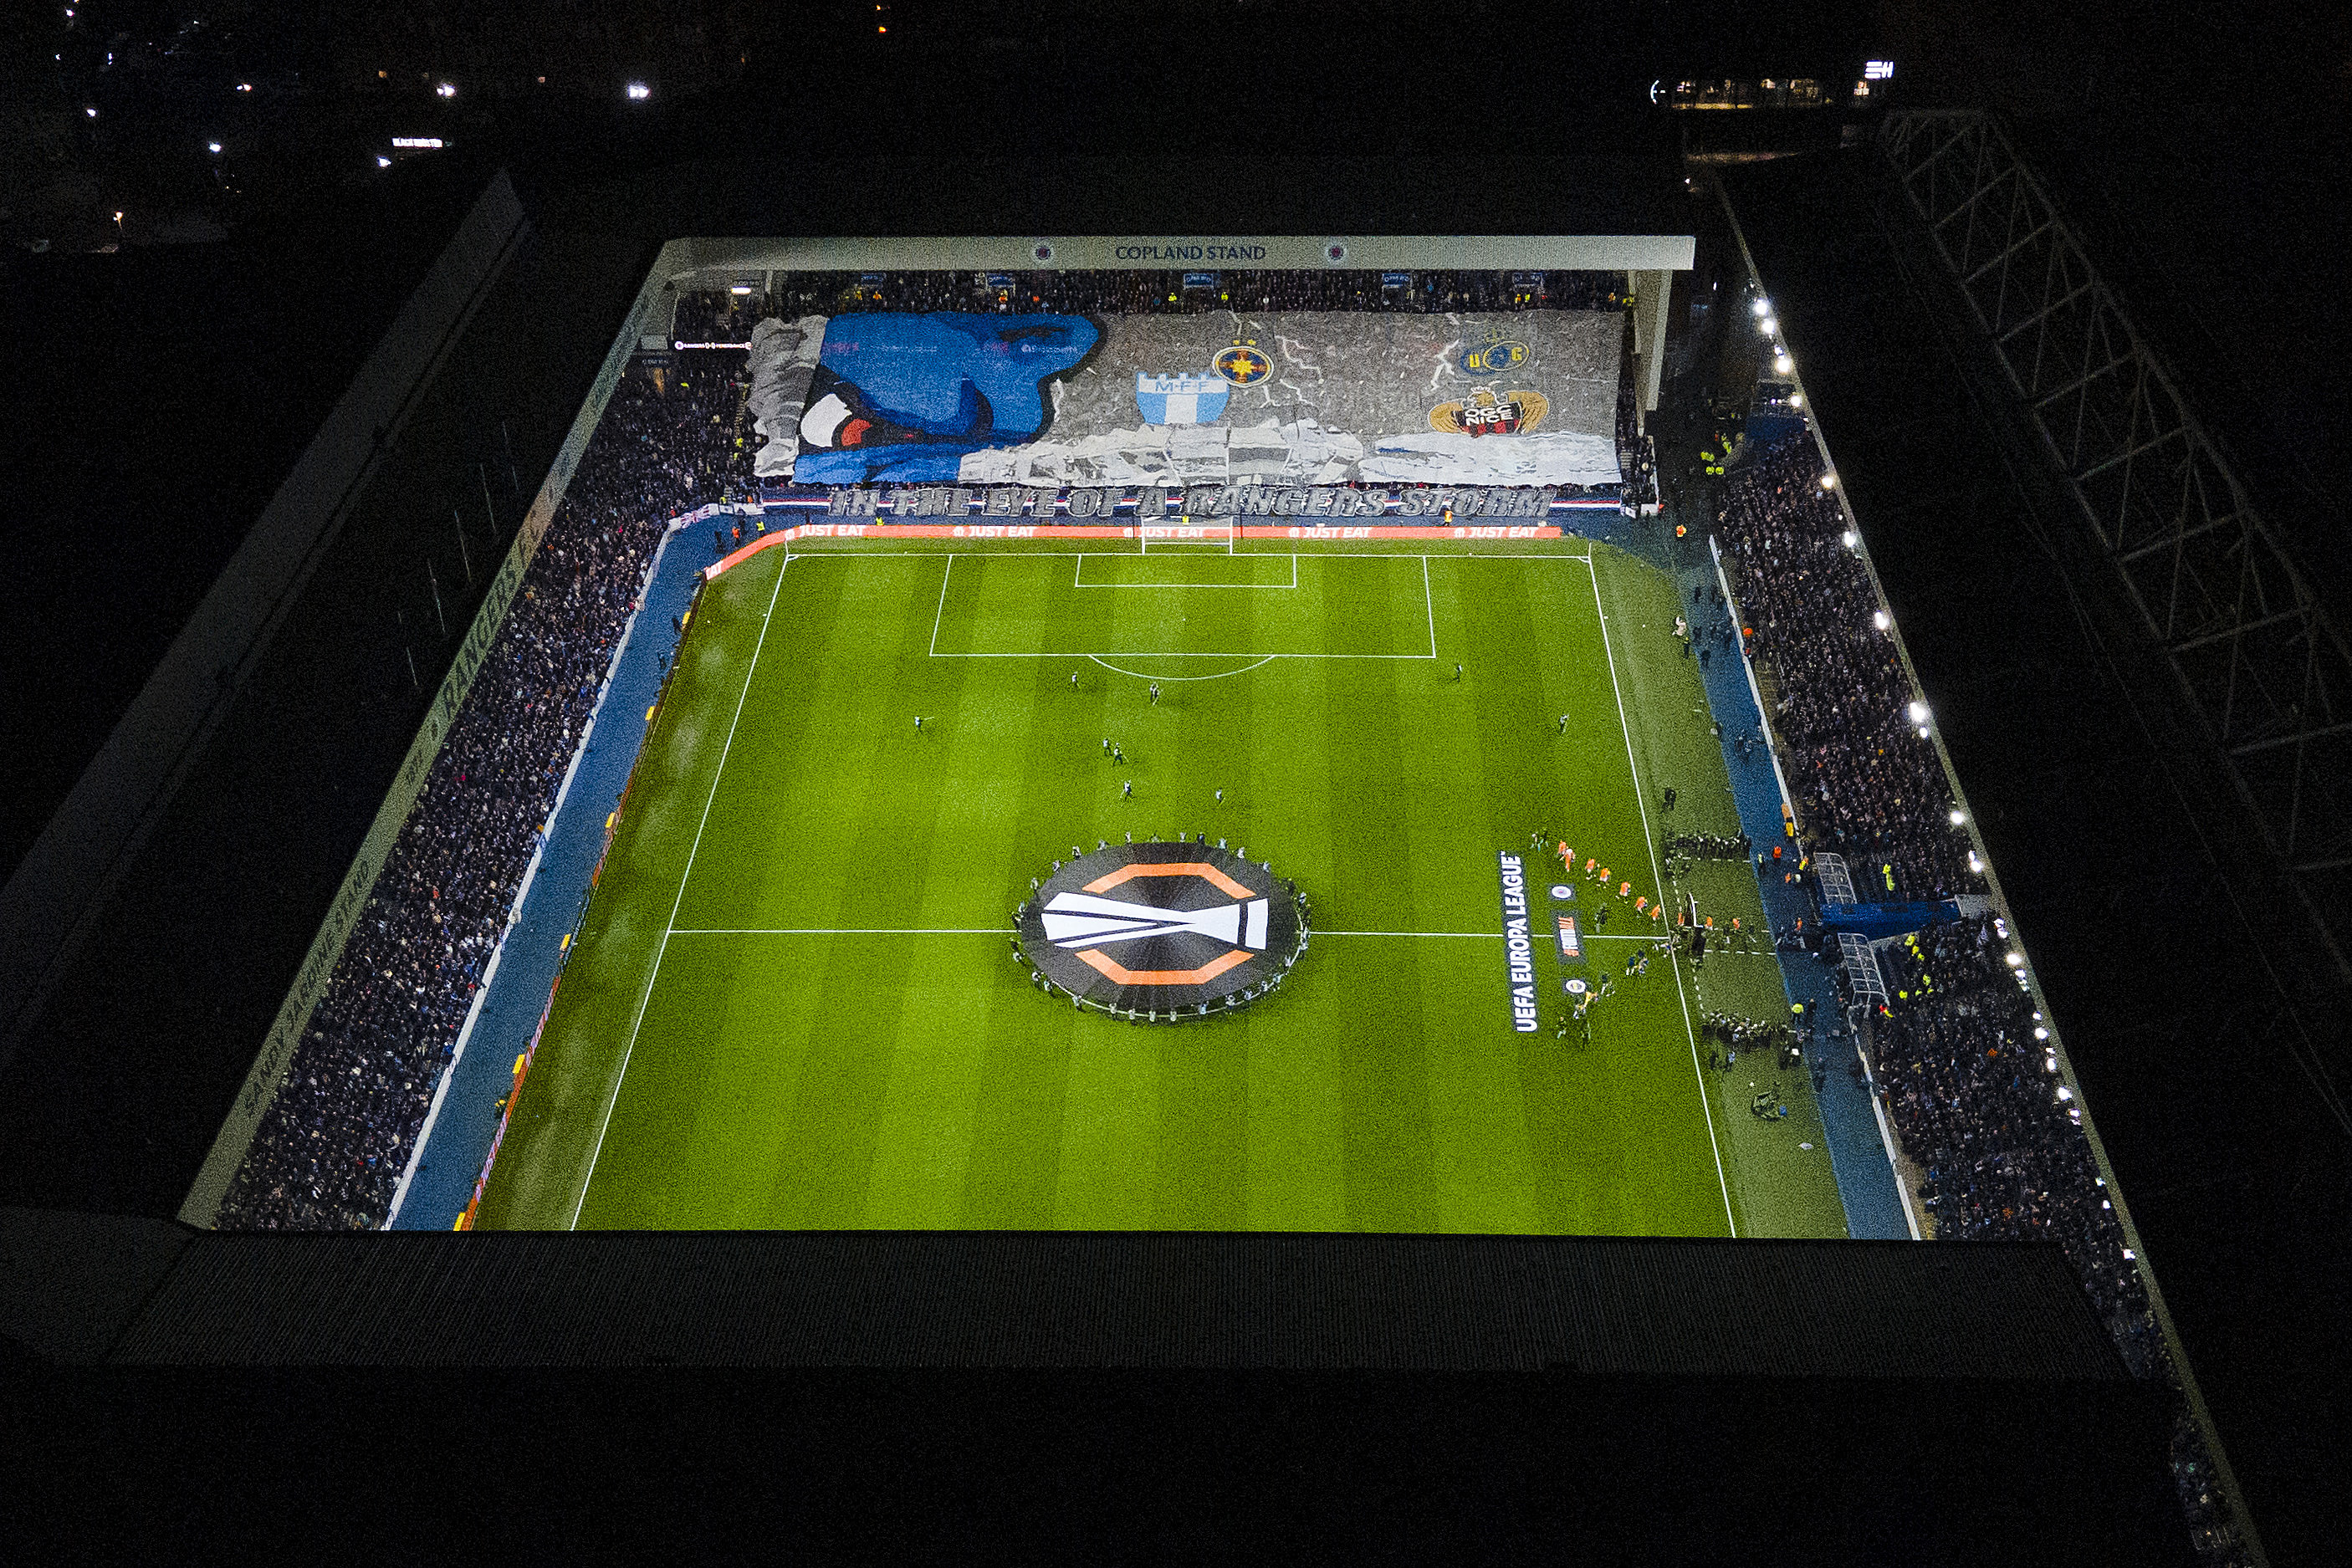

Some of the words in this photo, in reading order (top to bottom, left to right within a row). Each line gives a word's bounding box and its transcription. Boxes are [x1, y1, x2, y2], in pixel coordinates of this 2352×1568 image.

[1115, 246, 1203, 260] COPLAND
[1207, 246, 1266, 260] STAND
[1465, 405, 1513, 417] OGC
[1465, 412, 1513, 426] NICE
[828, 488, 880, 517] IN
[886, 488, 973, 517] THE
[981, 488, 1059, 517] EYE
[1067, 488, 1125, 517] OF
[1134, 488, 1168, 516] A
[1179, 486, 1391, 517] RANGERS
[1395, 488, 1557, 517] STORM
[799, 524, 834, 537] JUST
[837, 524, 867, 536] EAT
[968, 525, 1006, 537] JUST
[1007, 525, 1037, 537] EAT
[1177, 527, 1204, 538] EAT
[1303, 526, 1340, 538] JUST
[1342, 526, 1373, 538] EAT
[1468, 526, 1506, 538] JUST
[1509, 526, 1539, 538] EAT
[1501, 855, 1526, 916] LEAGUE
[1506, 917, 1532, 983] EUROPA
[1513, 986, 1538, 1033] UEFA
